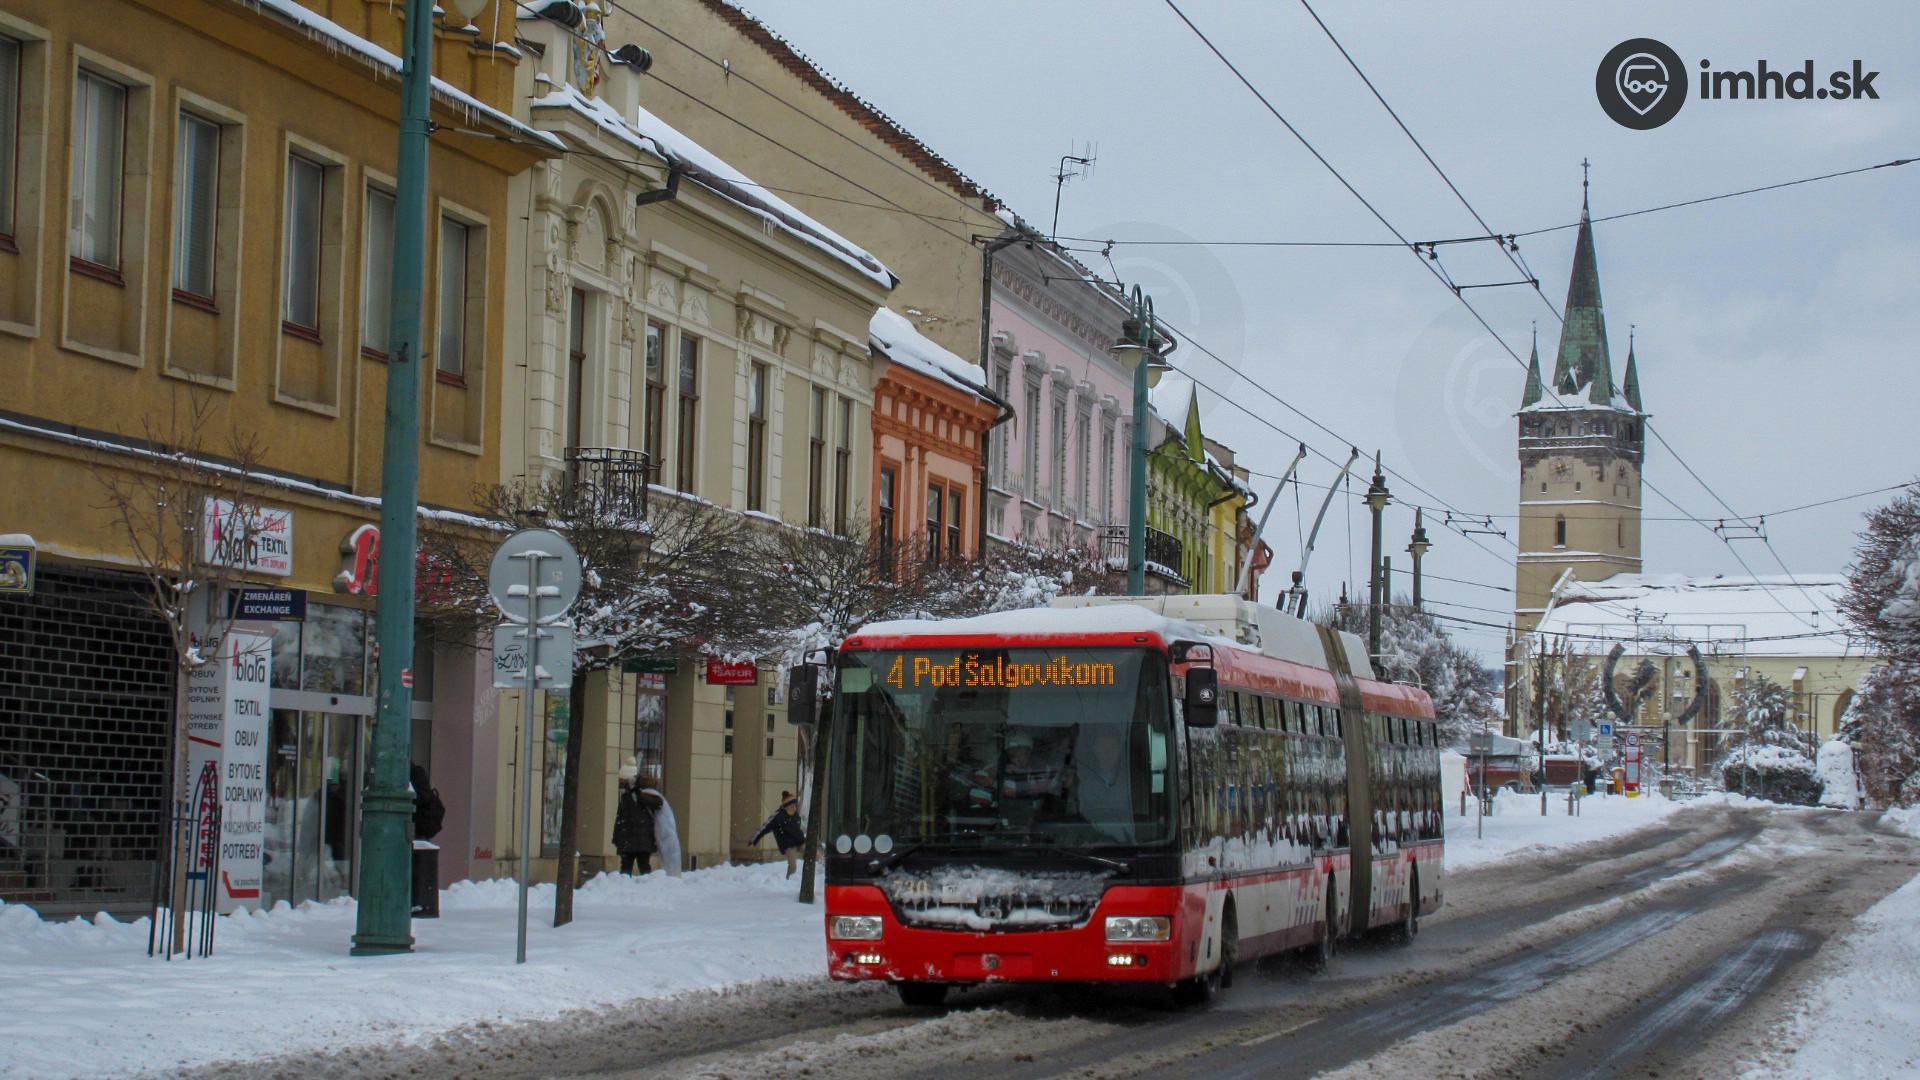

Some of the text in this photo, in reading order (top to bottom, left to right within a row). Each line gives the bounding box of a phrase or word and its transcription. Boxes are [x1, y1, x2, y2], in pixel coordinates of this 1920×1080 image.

[261, 537, 288, 555] TEXTIL
[244, 590, 292, 601] ZMENÁREŇ
[244, 604, 291, 614] EXCHANGE
[716, 669, 752, 677] SATUR
[887, 653, 1114, 688] 4 Pod Šalgovíkom
[234, 698, 261, 717] TEXTIL
[188, 722, 219, 730] OTREBY
[234, 730, 259, 747] OBUV
[228, 760, 261, 780] BYTOVÉ
[225, 786, 263, 802] DOPLNKY
[222, 843, 261, 860] POTREBY
